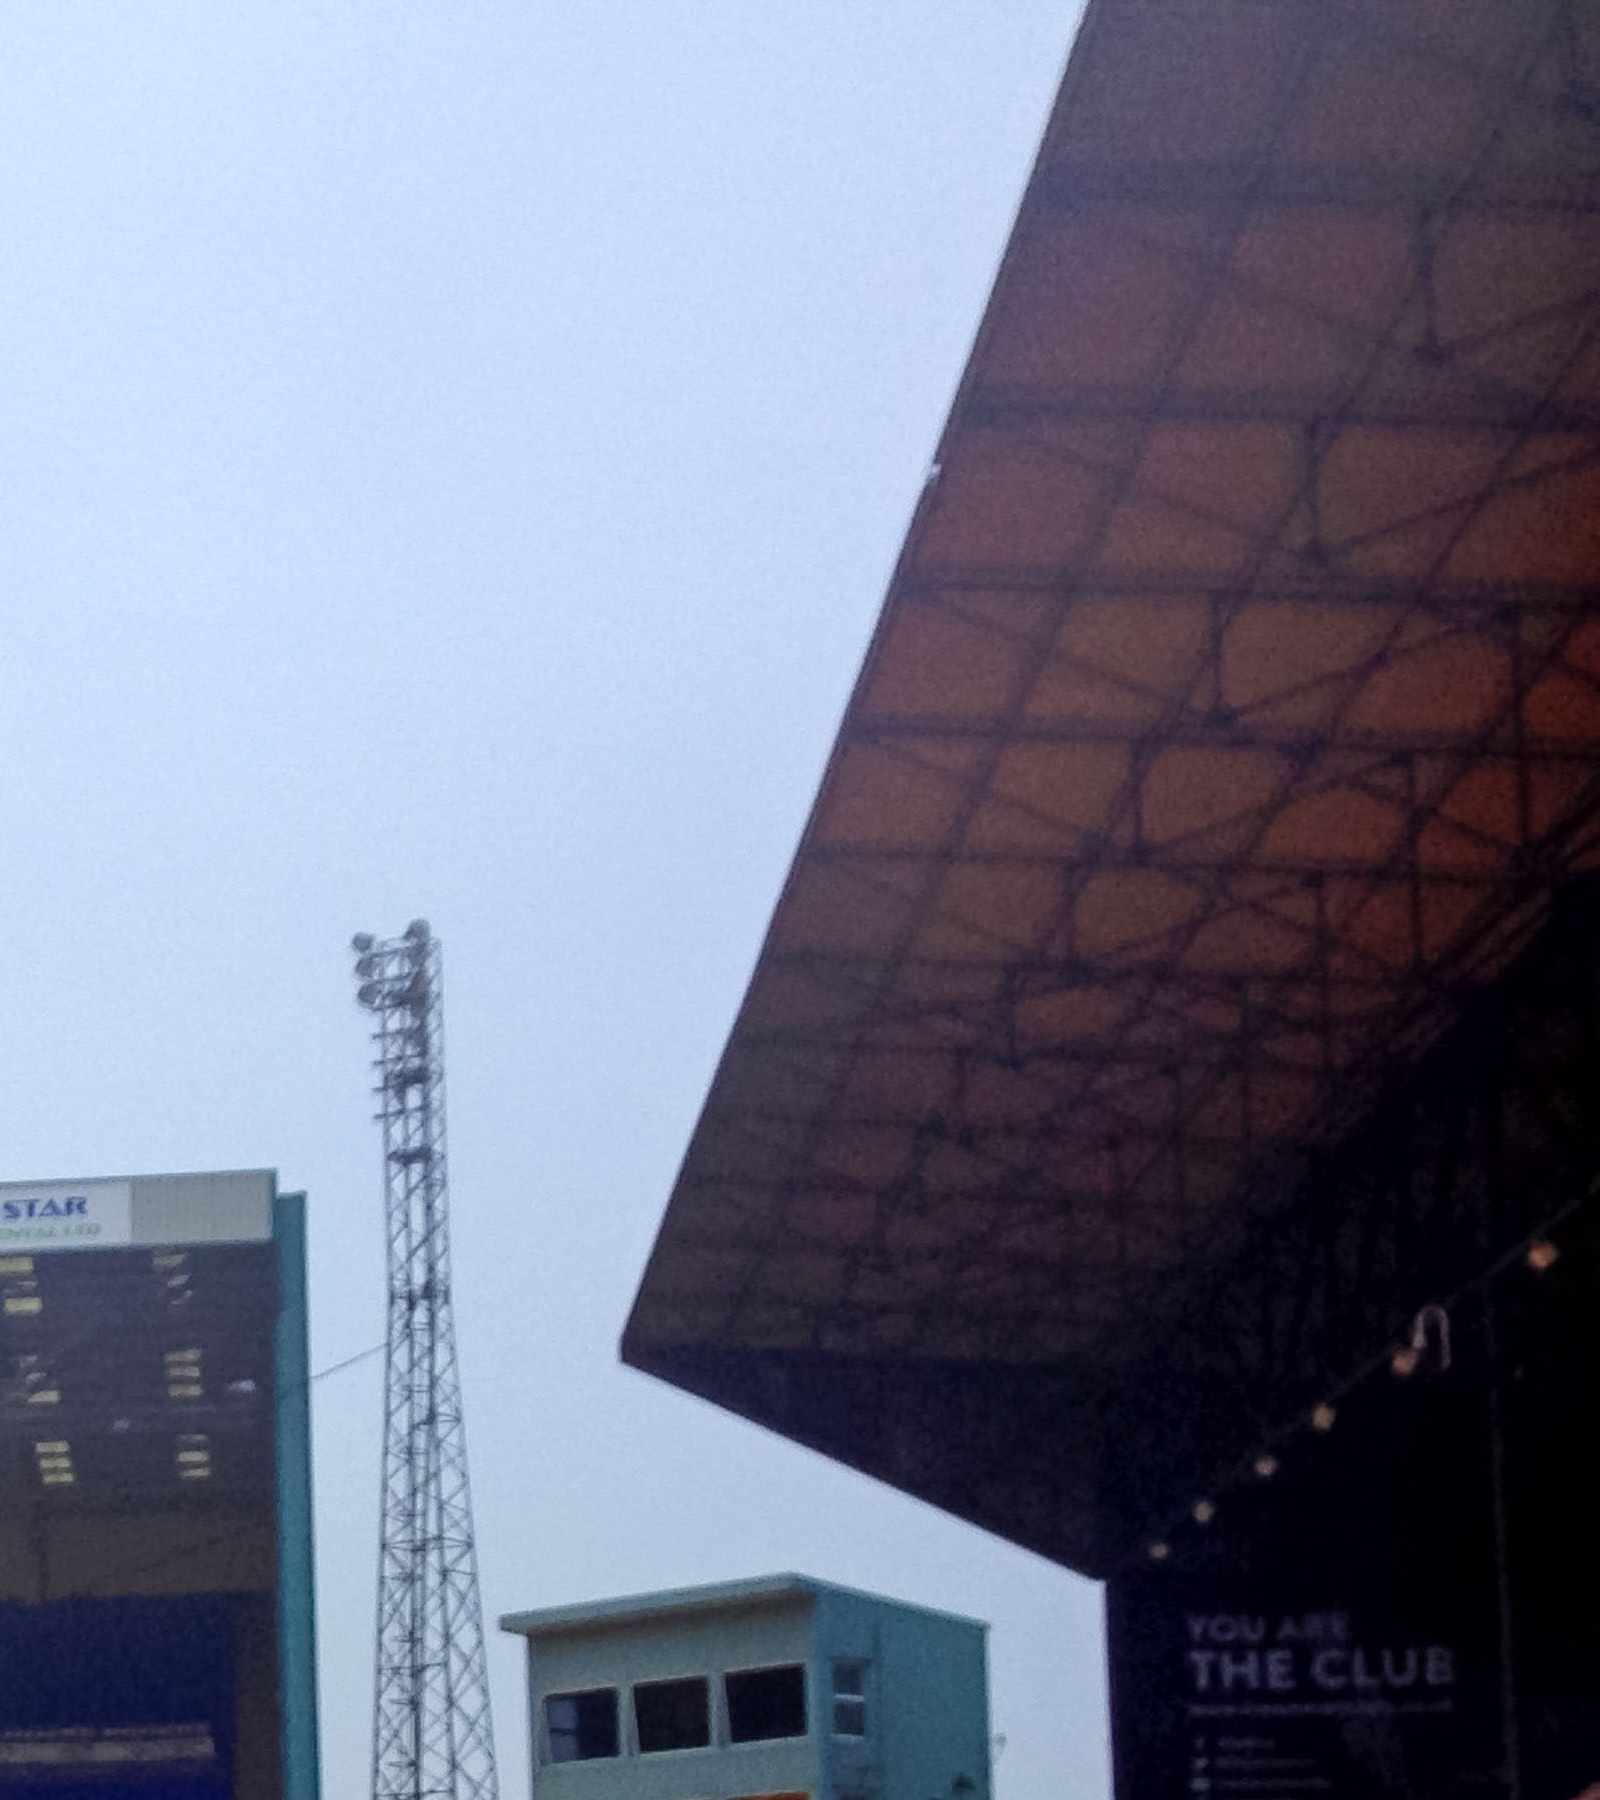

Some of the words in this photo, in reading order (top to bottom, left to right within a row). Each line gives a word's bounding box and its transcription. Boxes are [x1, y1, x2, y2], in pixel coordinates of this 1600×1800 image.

[2, 1196, 88, 1219] STAR
[1185, 1613, 1267, 1643] YOU
[1187, 1647, 1297, 1691] THE
[1310, 1645, 1456, 1691] CLUB
